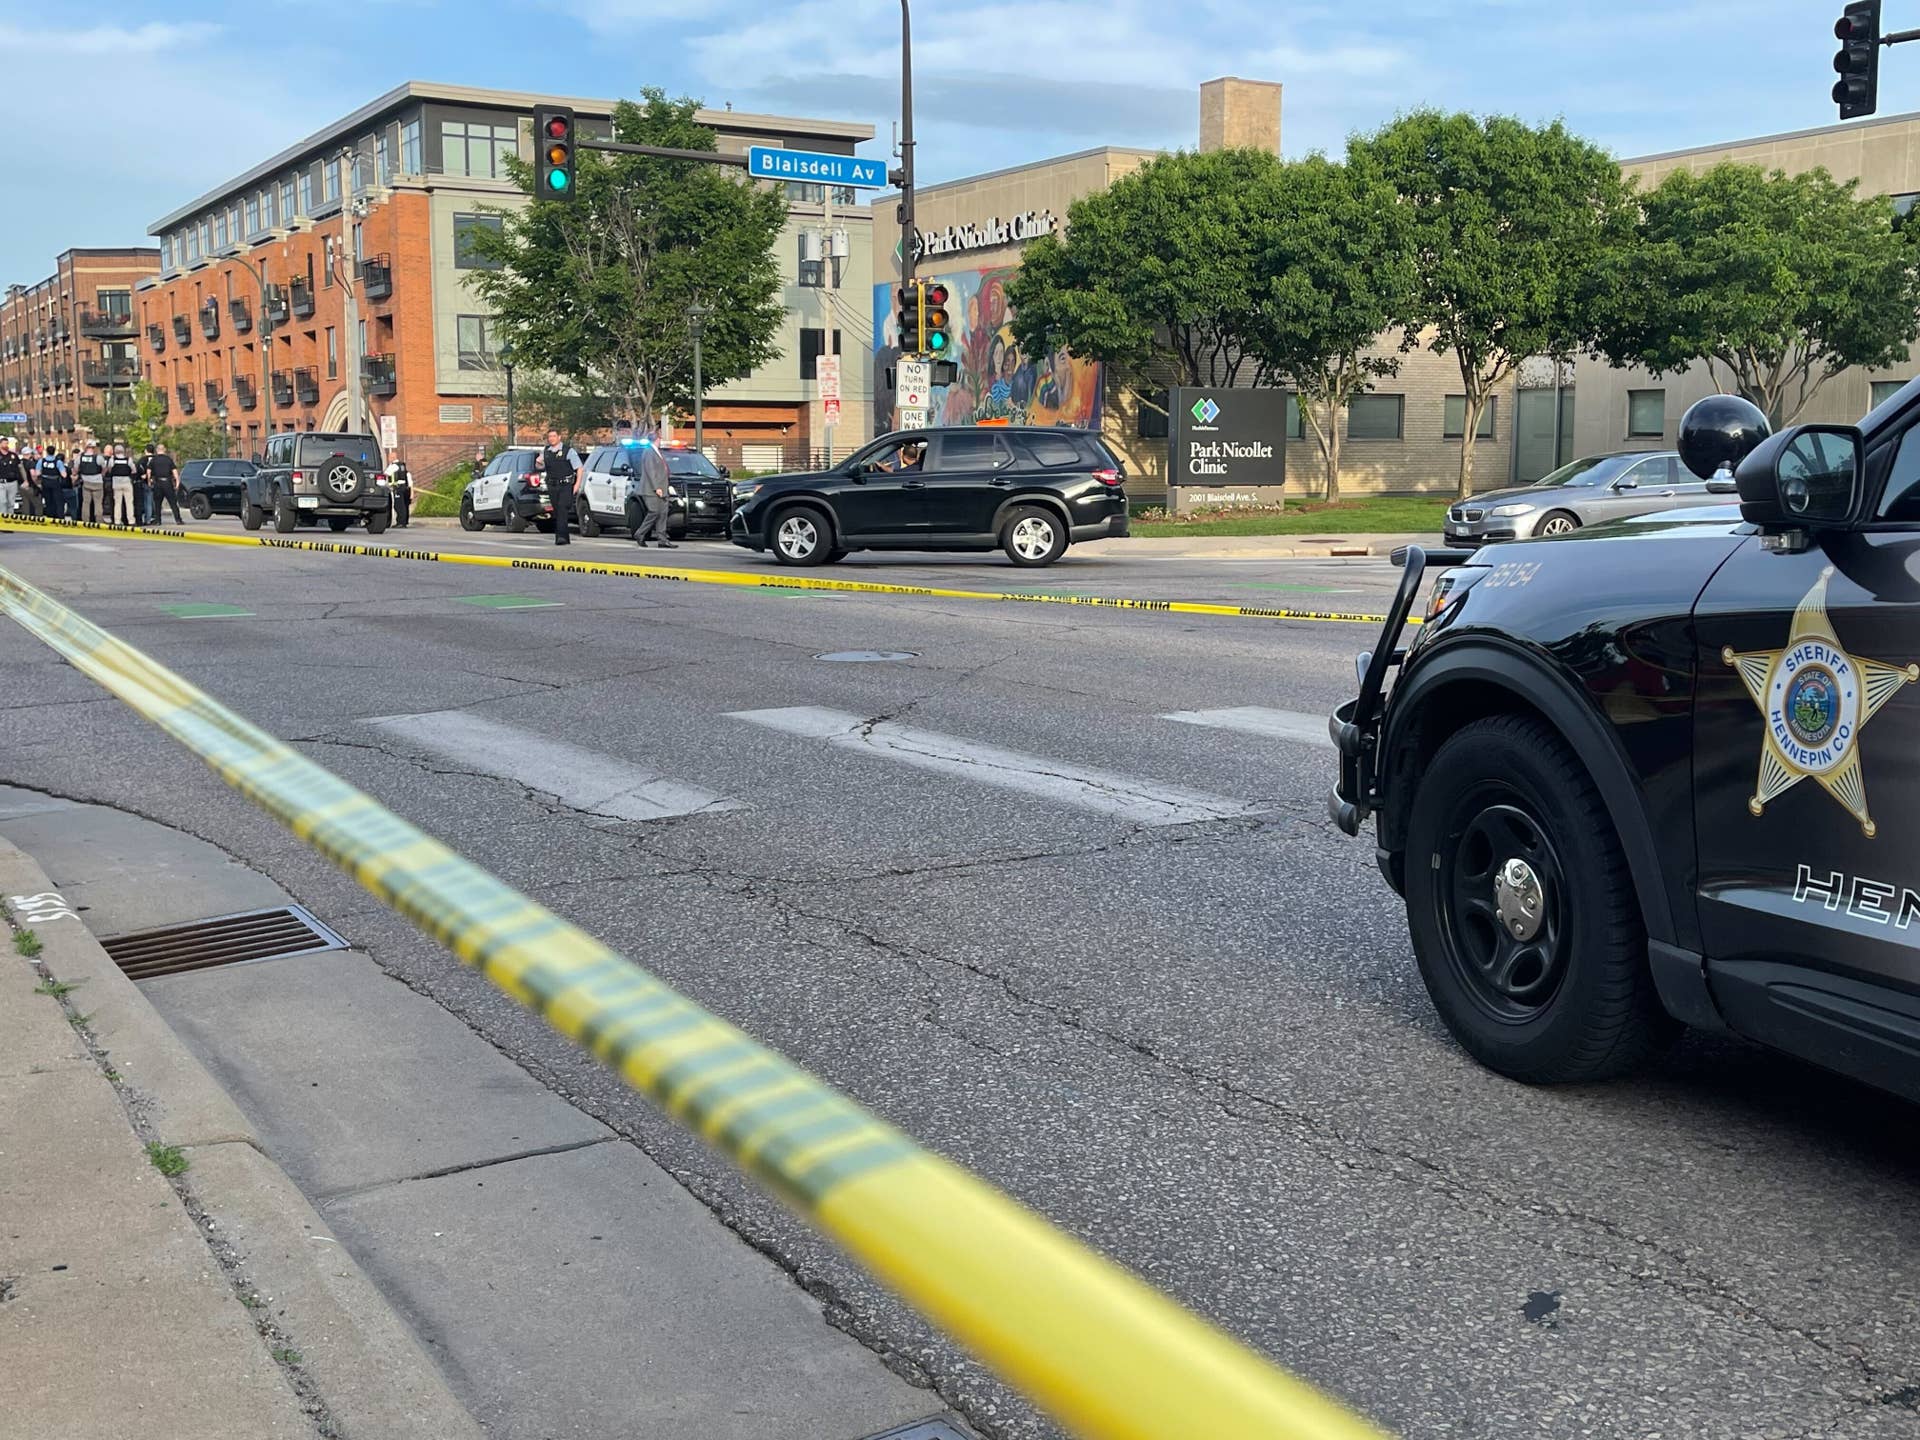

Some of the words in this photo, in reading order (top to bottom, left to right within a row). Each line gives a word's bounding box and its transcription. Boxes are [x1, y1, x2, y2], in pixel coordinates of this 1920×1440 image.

[852, 164, 875, 181] Av
[923, 226, 957, 256] Park
[955, 216, 1010, 250] Nicollet
[1010, 209, 1058, 241] Clinic
[906, 364, 921, 375] NO
[904, 375, 924, 383] TURN
[900, 385, 911, 393] ON
[912, 385, 928, 394] RED
[904, 411, 923, 421] ONE
[904, 422, 924, 430] WAY
[1190, 441, 1221, 458] Park
[1222, 441, 1273, 458] Nicollet
[1189, 458, 1228, 475] Clinic
[1189, 493, 1206, 502] 2001
[1207, 493, 1235, 502] Blaisdell
[1786, 645, 1850, 675] SHERIFF
[1798, 671, 1821, 685] STATE
[1822, 676, 1833, 688] OF
[1771, 710, 1832, 766] HENNEPIN
[1835, 720, 1853, 752] CO.
[1791, 719, 1831, 741] MINNESOTA
